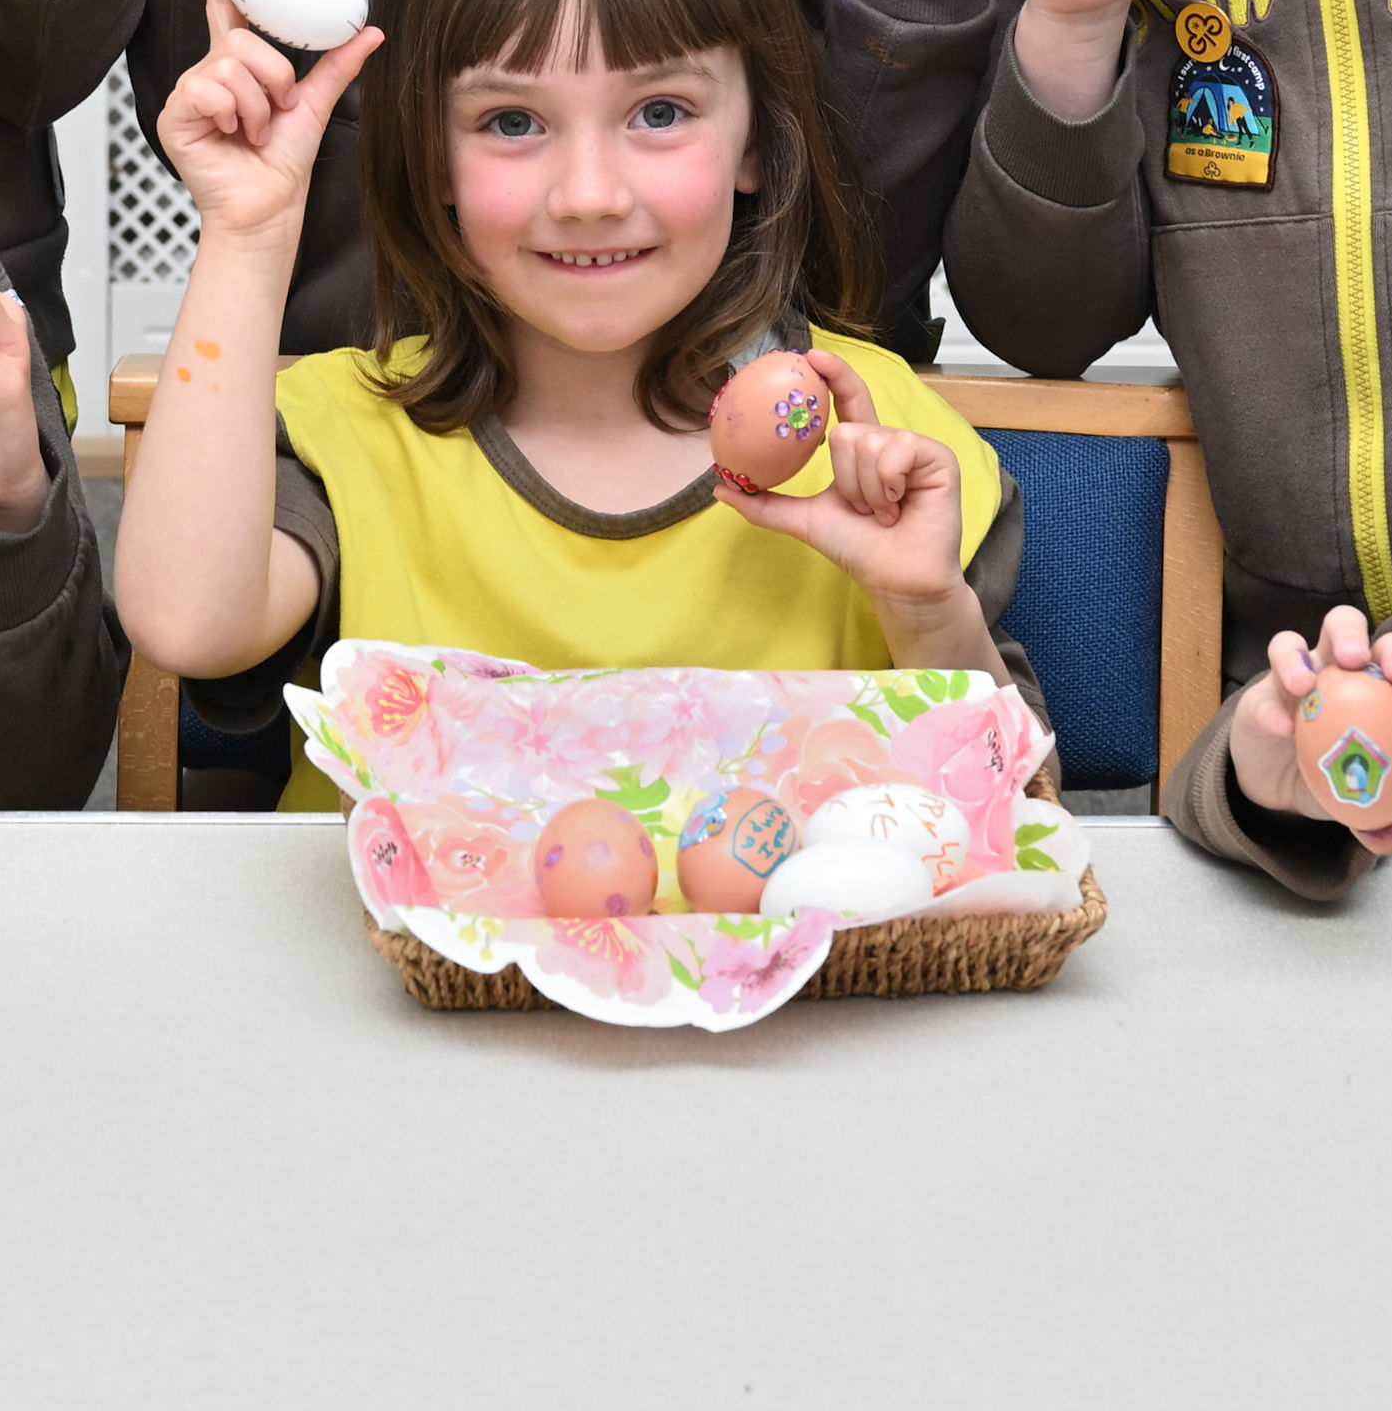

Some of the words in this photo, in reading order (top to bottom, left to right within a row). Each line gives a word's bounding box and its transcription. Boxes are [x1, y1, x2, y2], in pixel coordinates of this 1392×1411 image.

[1232, 45, 1250, 64] first
[1248, 59, 1266, 92] camp
[1185, 147, 1196, 157] as
[1204, 148, 1246, 162] Brownie
